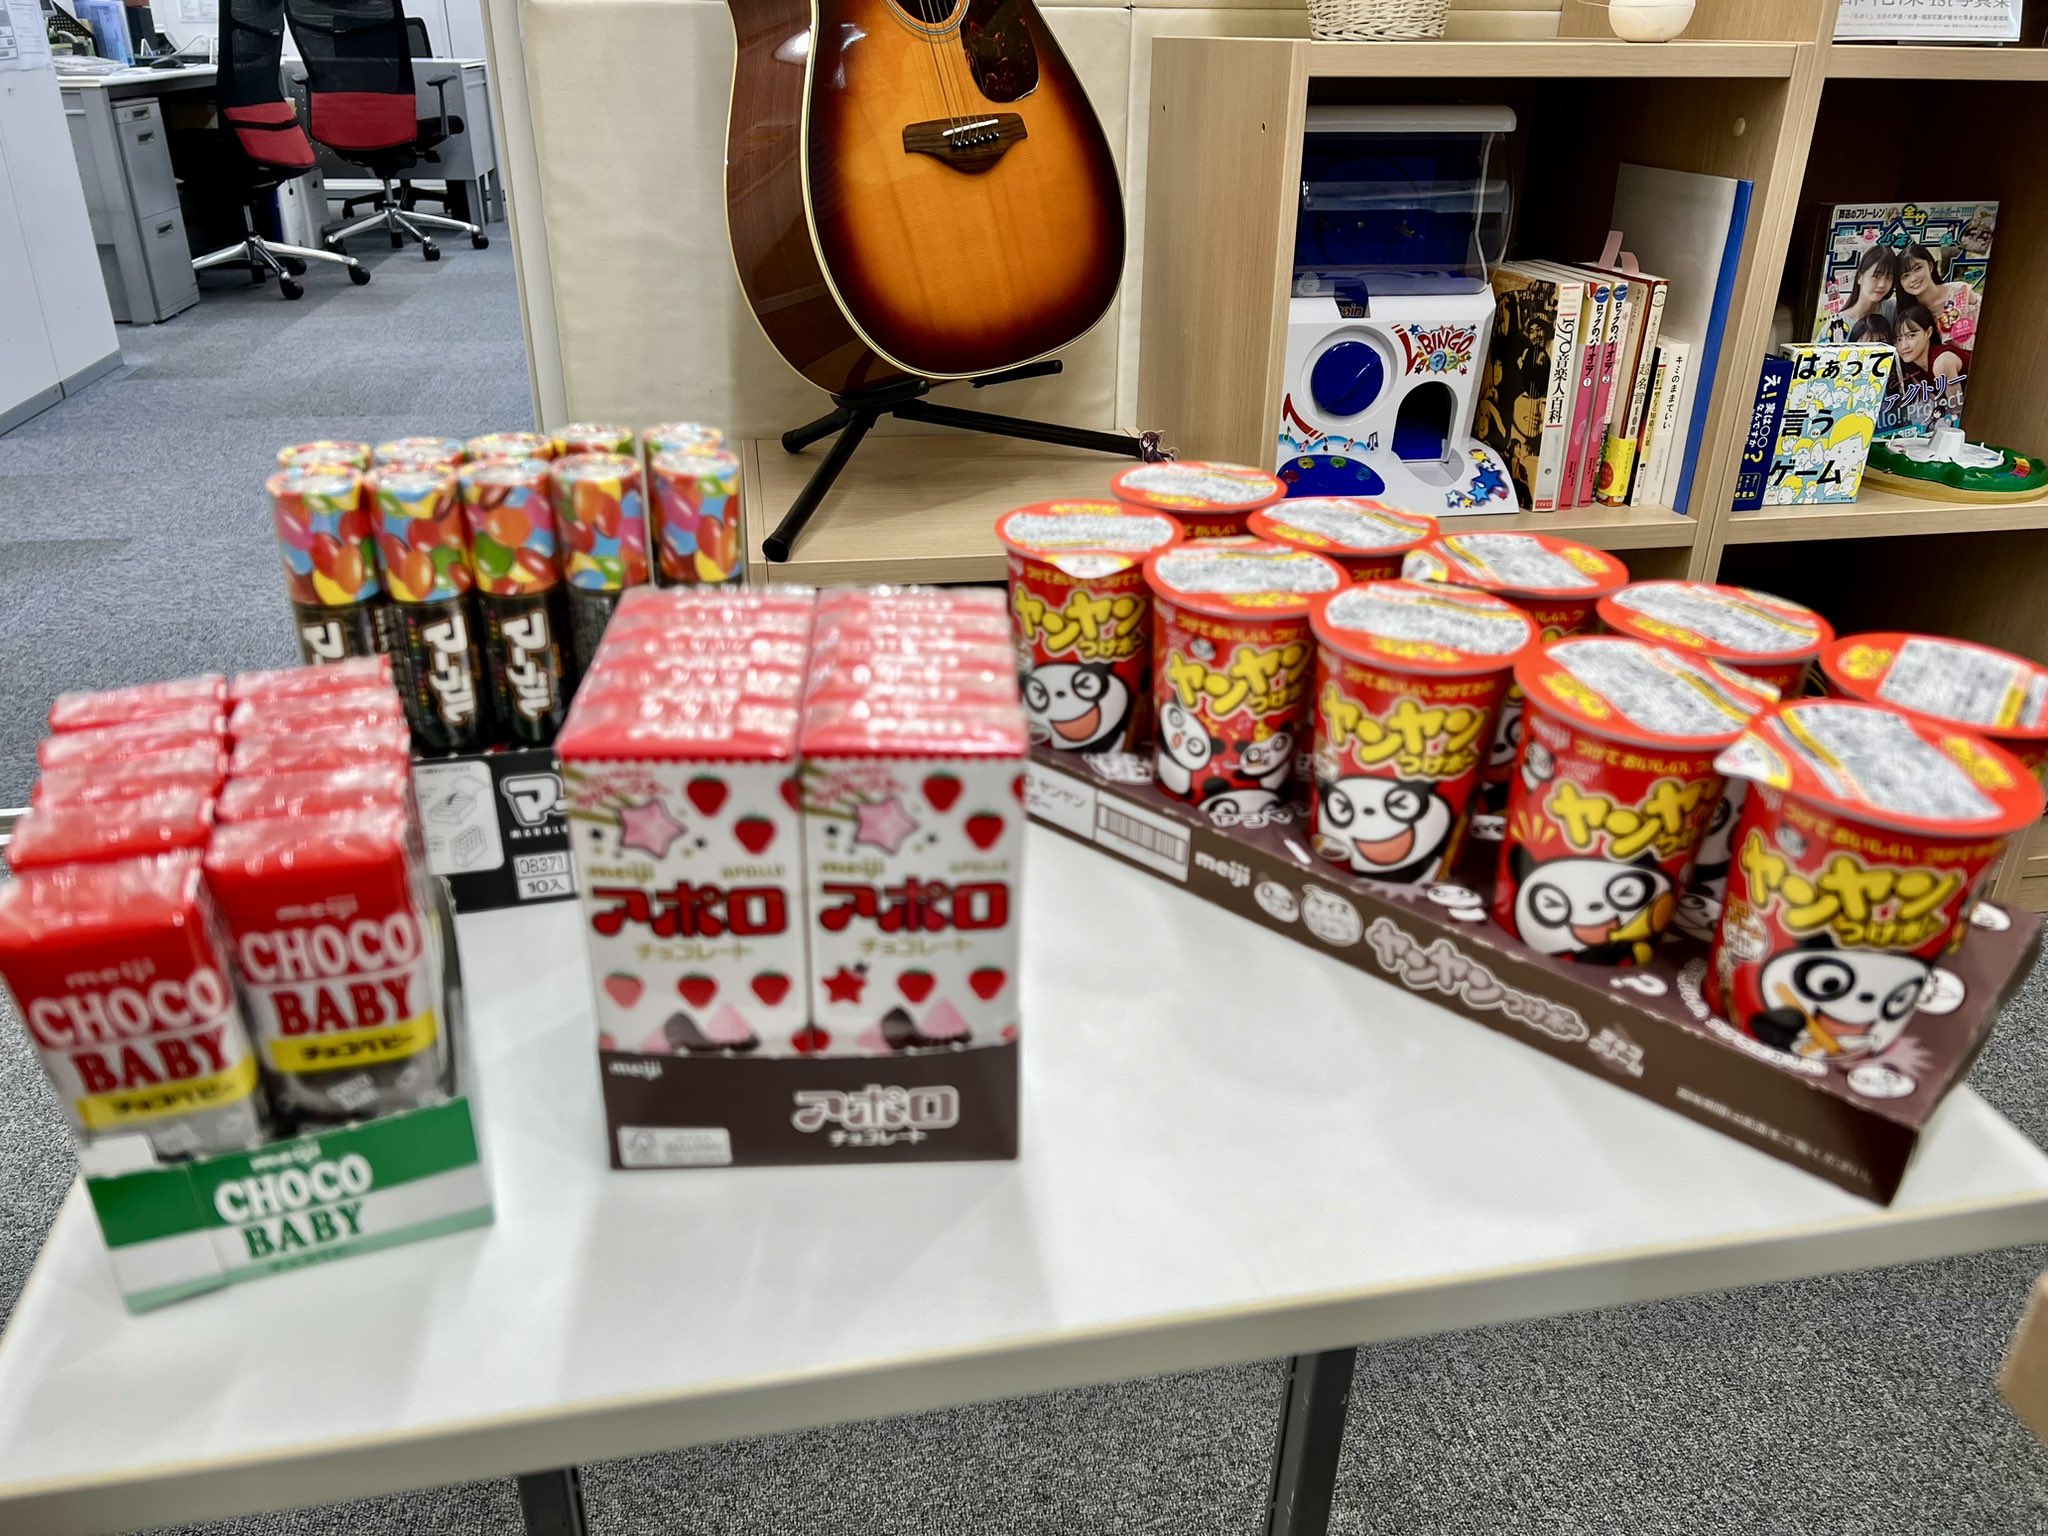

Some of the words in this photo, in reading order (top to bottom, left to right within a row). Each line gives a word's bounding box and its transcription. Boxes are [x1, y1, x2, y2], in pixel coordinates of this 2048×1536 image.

[1417, 330, 1475, 355] BINGO
[1548, 318, 1575, 424] 1970音楽人百科
[1793, 352, 1894, 379] はぁって
[1662, 355, 1684, 430] キミのままでいい
[1876, 409, 1902, 429] llo!
[1781, 409, 1834, 437] 言う
[1770, 459, 1842, 486] ゲーム
[1015, 586, 1147, 652] ヤンヤン
[1170, 648, 1310, 716] ヤンヤン
[1322, 684, 1489, 765] ヤンヤン
[1397, 748, 1476, 777] つけボー
[587, 863, 655, 883] meiji
[1195, 851, 1250, 888] meiji
[1741, 831, 1961, 930] ヤンヤン
[276, 893, 359, 921] meiji
[591, 880, 788, 938] アポロ
[819, 875, 1009, 933] アポロ
[65, 957, 156, 989] meiji
[240, 912, 415, 982] CHOCO
[635, 942, 753, 962] チョコレート
[28, 966, 223, 1048] CHOCO
[272, 973, 412, 1037] BABY
[72, 1024, 227, 1095] BABY
[609, 1060, 663, 1080] meiji
[791, 1084, 960, 1133] アポロ
[214, 1153, 373, 1224] CHOCO
[244, 1201, 363, 1258] BABY
